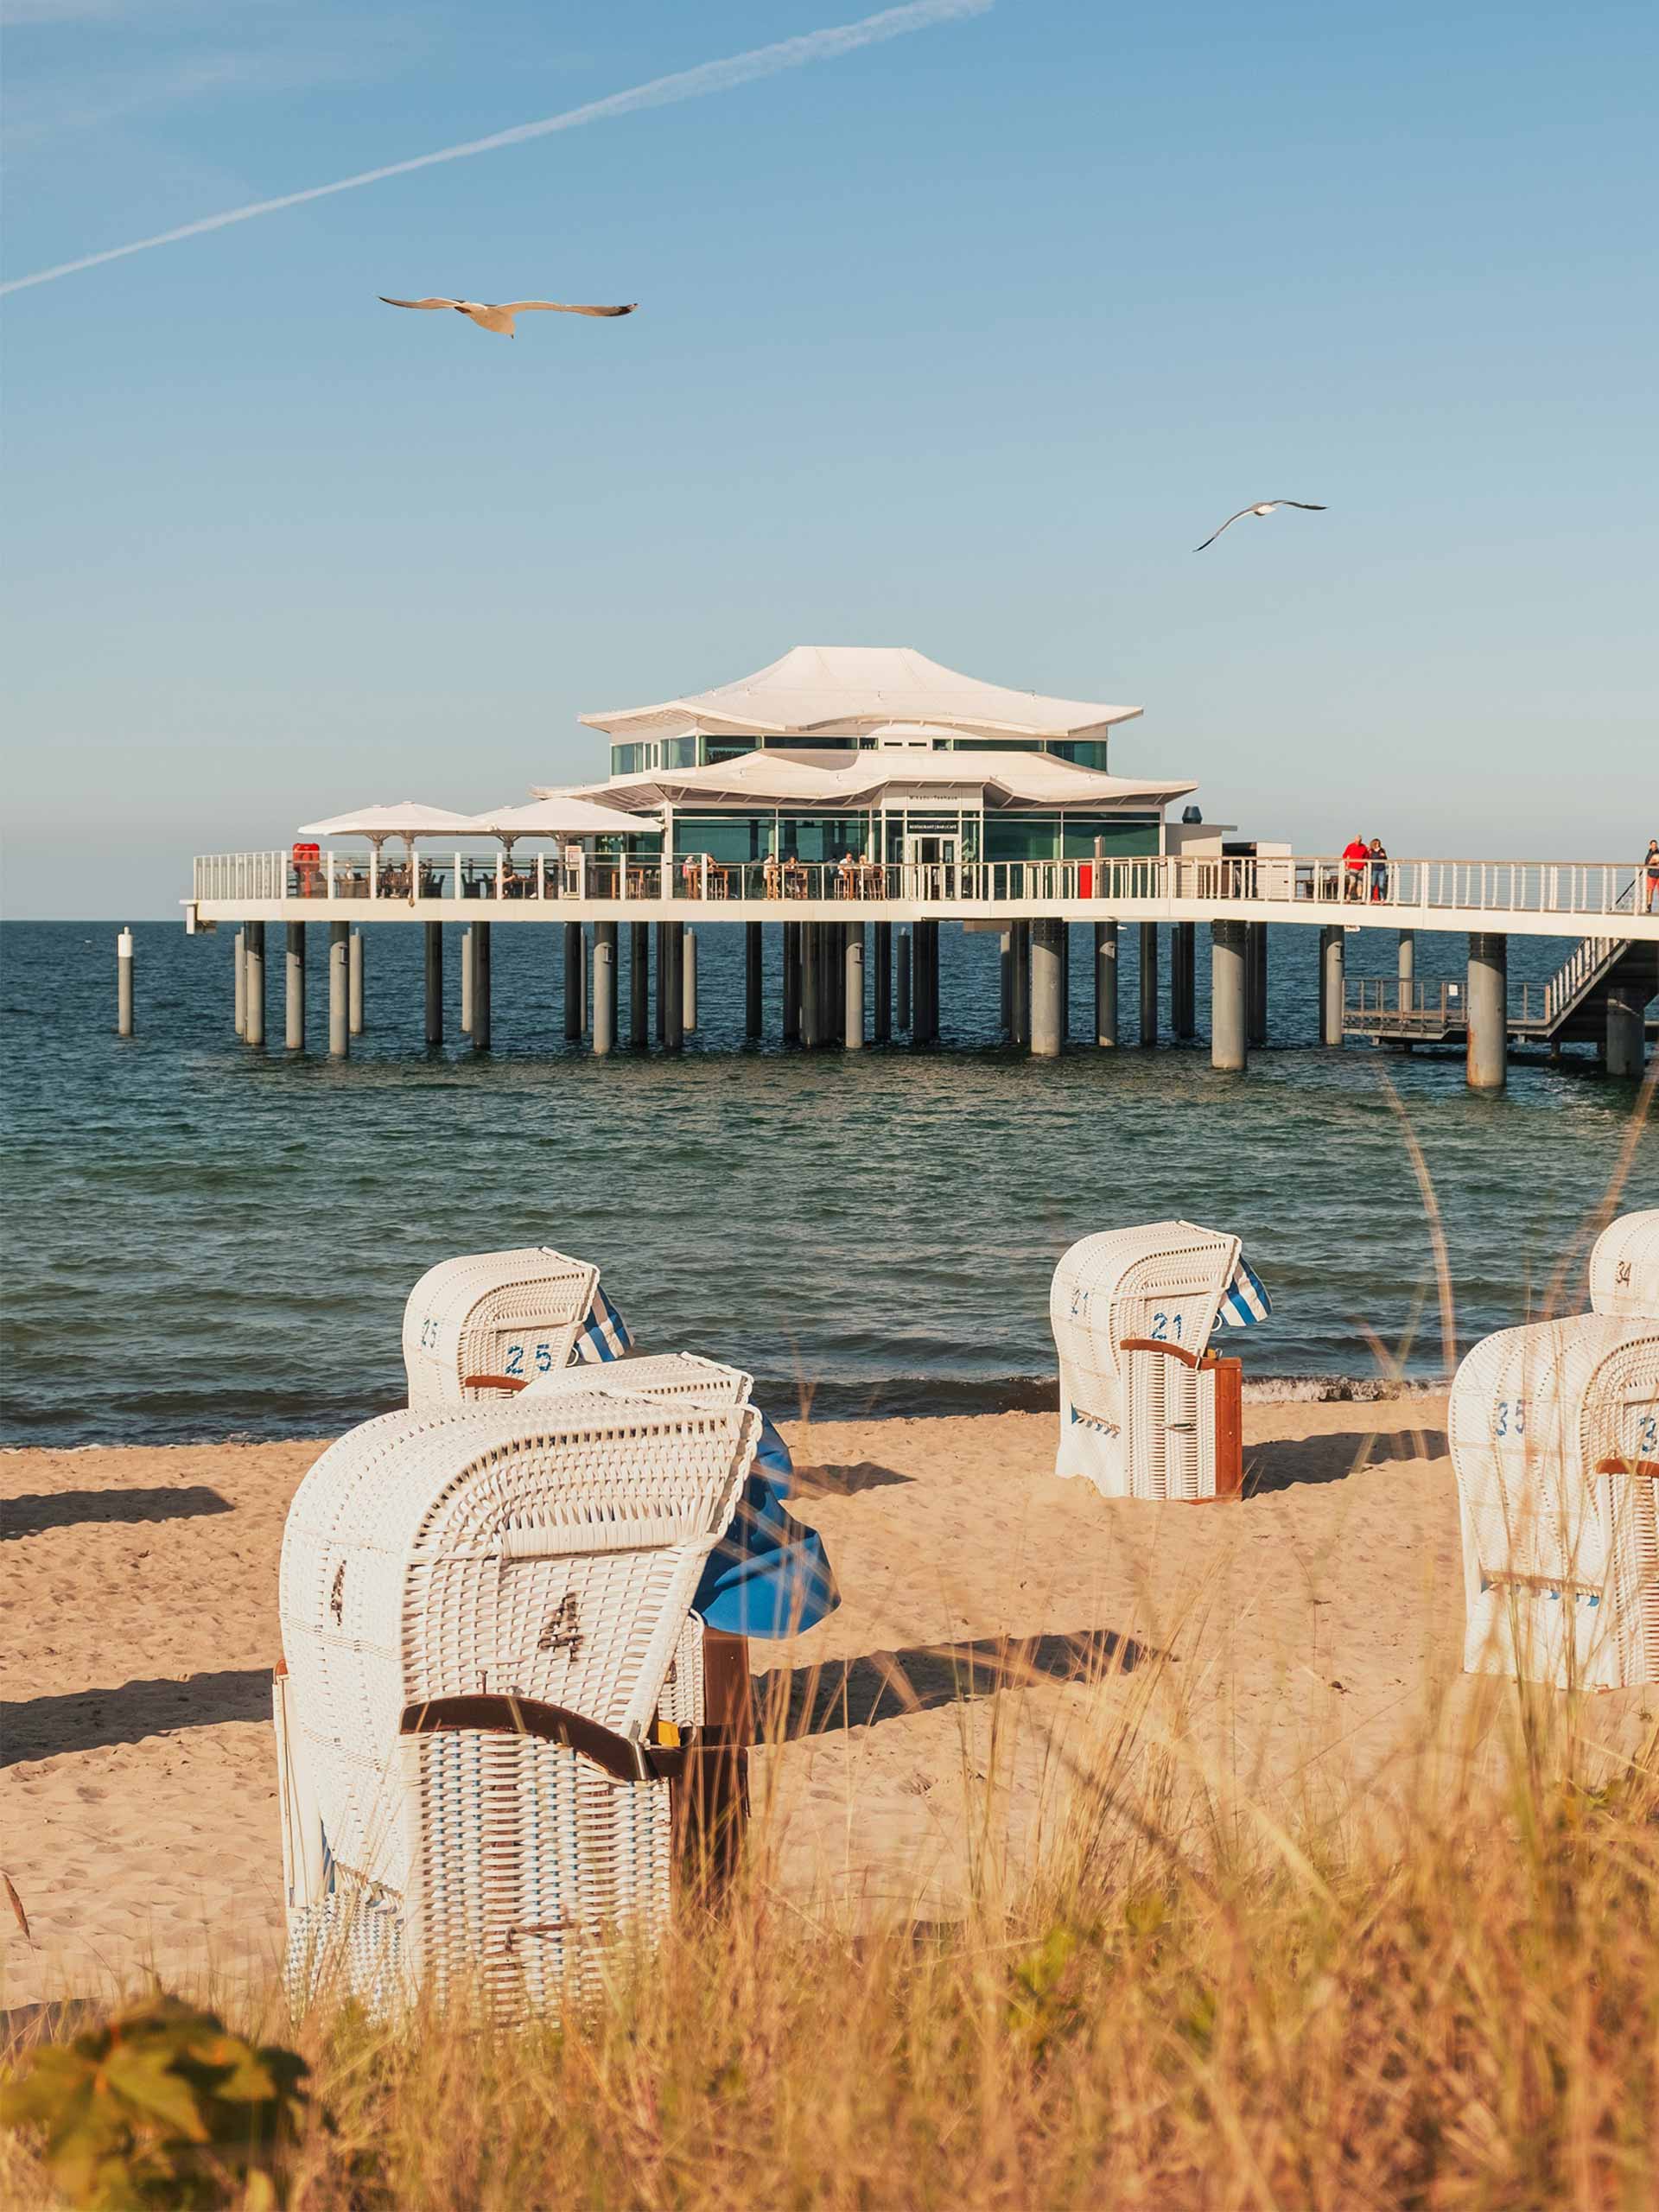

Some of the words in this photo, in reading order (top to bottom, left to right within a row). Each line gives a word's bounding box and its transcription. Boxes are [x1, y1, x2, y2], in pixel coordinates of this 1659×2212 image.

[1615, 1260, 1632, 1287] 34
[1151, 1313, 1183, 1340] 21
[505, 1344, 553, 1375] 25
[1494, 1400, 1526, 1437] 35
[537, 1592, 585, 1663] 4
